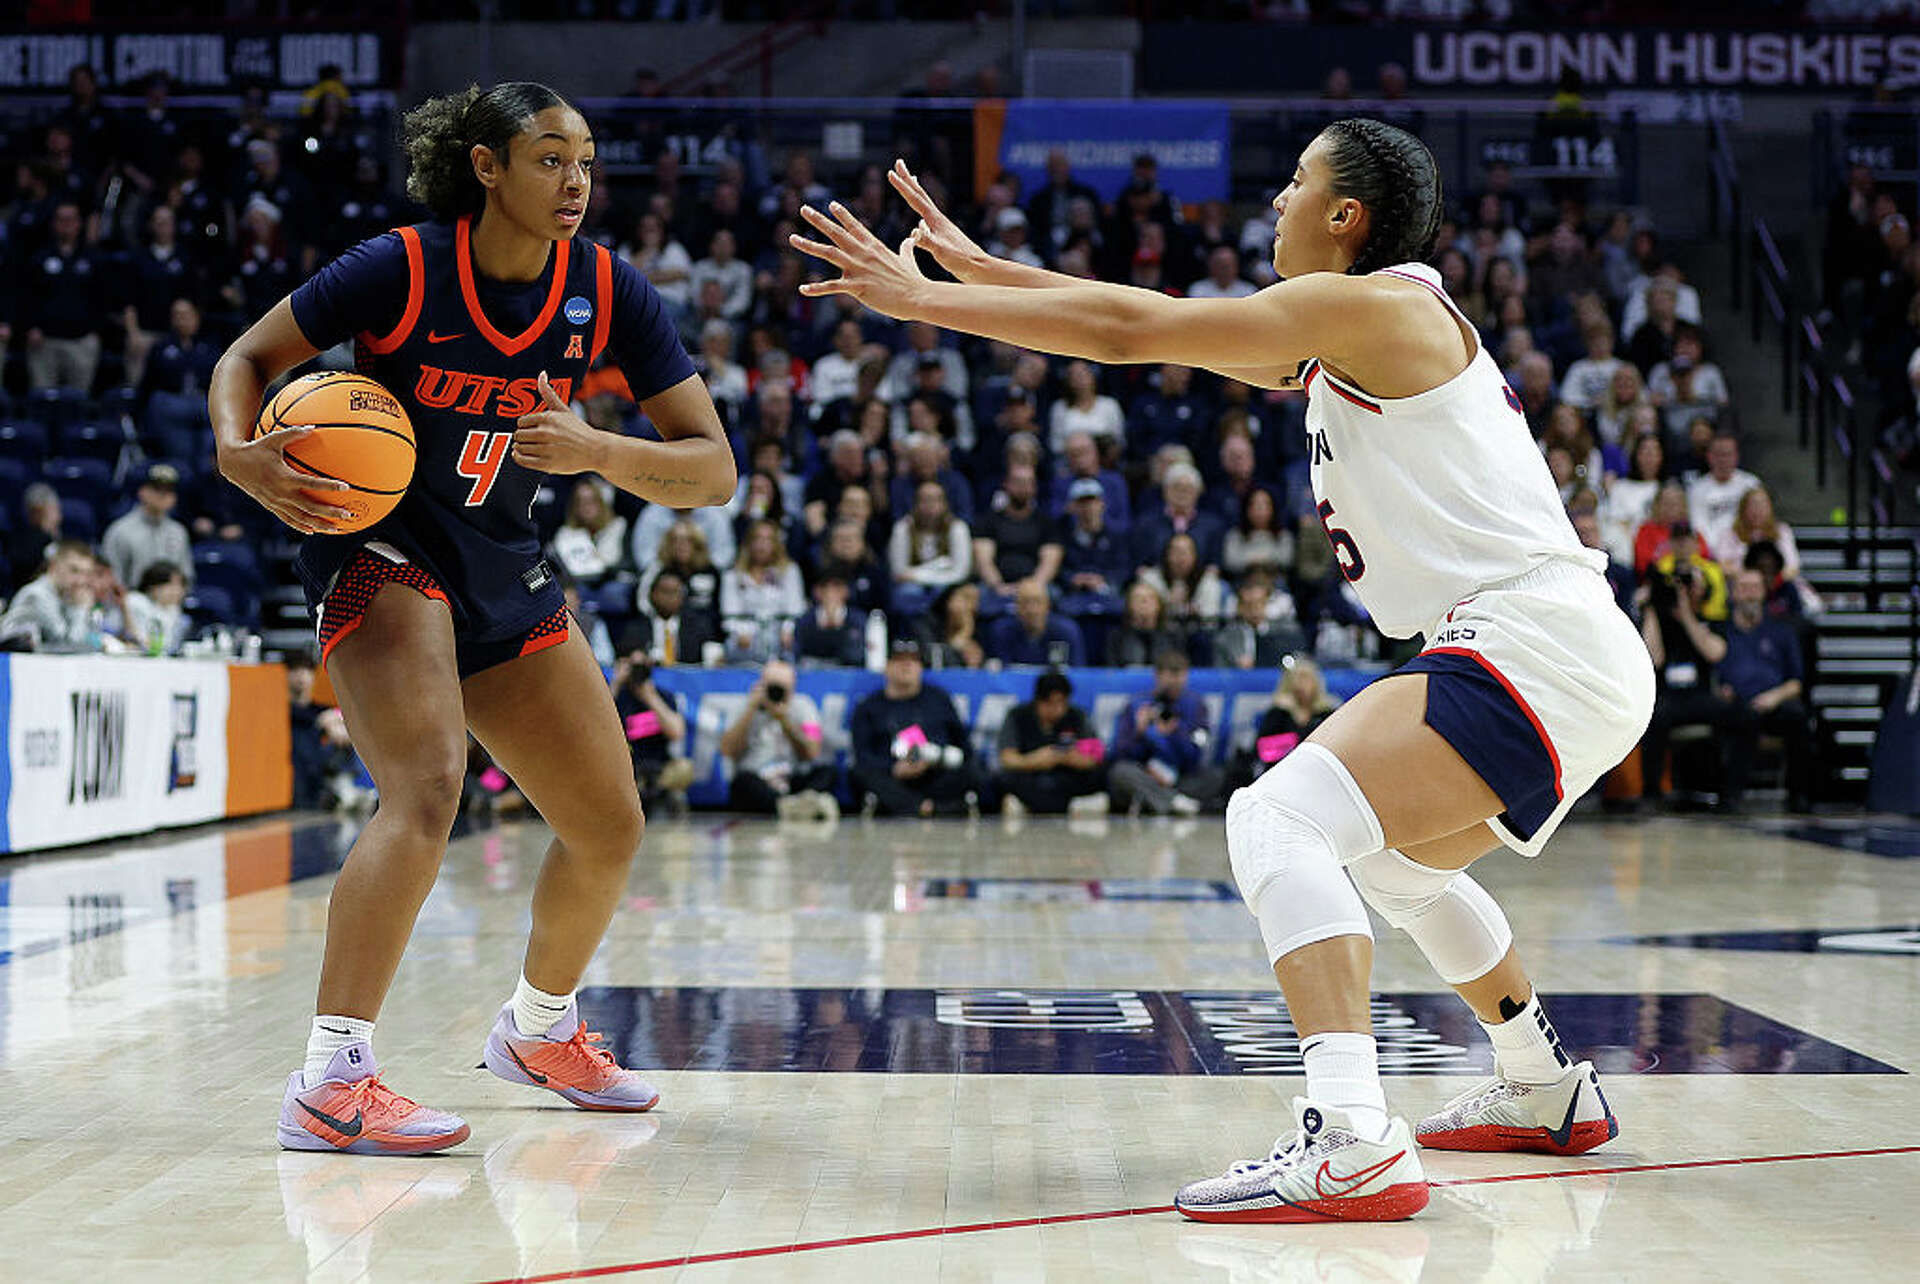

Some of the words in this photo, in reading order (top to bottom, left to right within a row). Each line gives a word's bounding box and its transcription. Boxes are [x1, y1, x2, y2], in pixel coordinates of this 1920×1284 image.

[1413, 31, 1637, 84] UCONN
[1655, 31, 1920, 86] HUSKIES
[1551, 136, 1616, 175] 114
[456, 430, 513, 507] 4
